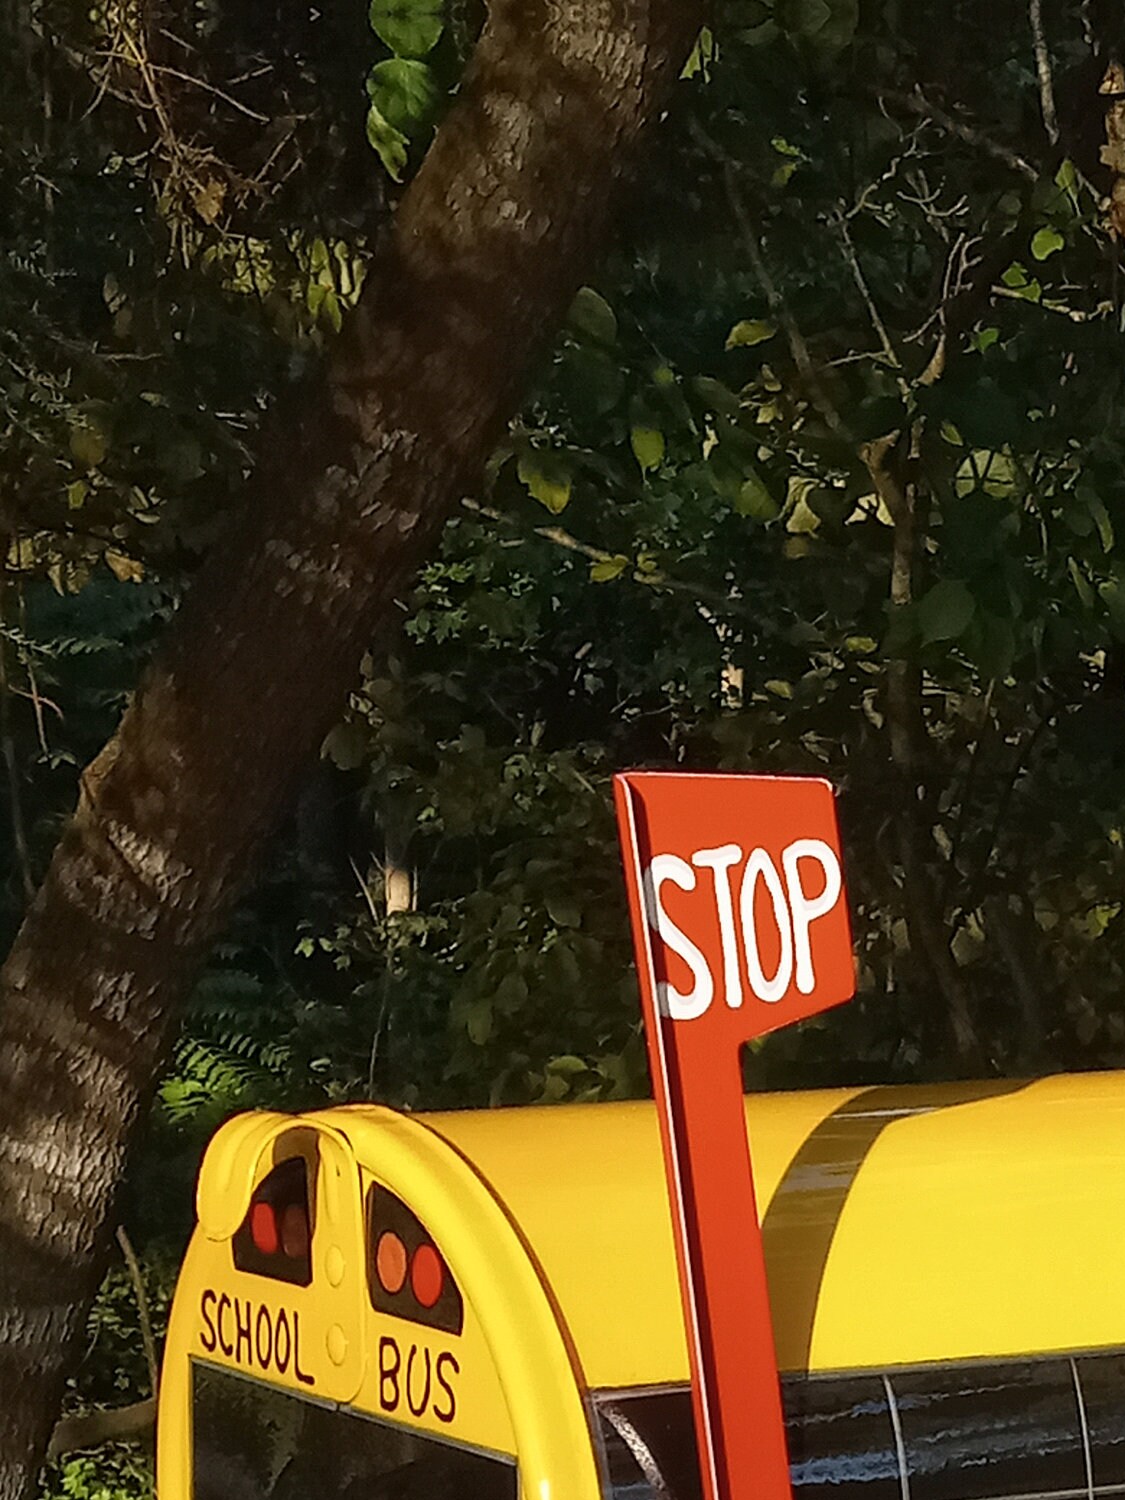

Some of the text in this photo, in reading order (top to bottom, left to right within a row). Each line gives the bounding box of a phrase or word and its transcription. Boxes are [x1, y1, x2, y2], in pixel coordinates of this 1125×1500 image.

[644, 838, 842, 1020] STOP
[200, 1289, 460, 1422] SCHOOL BUS
